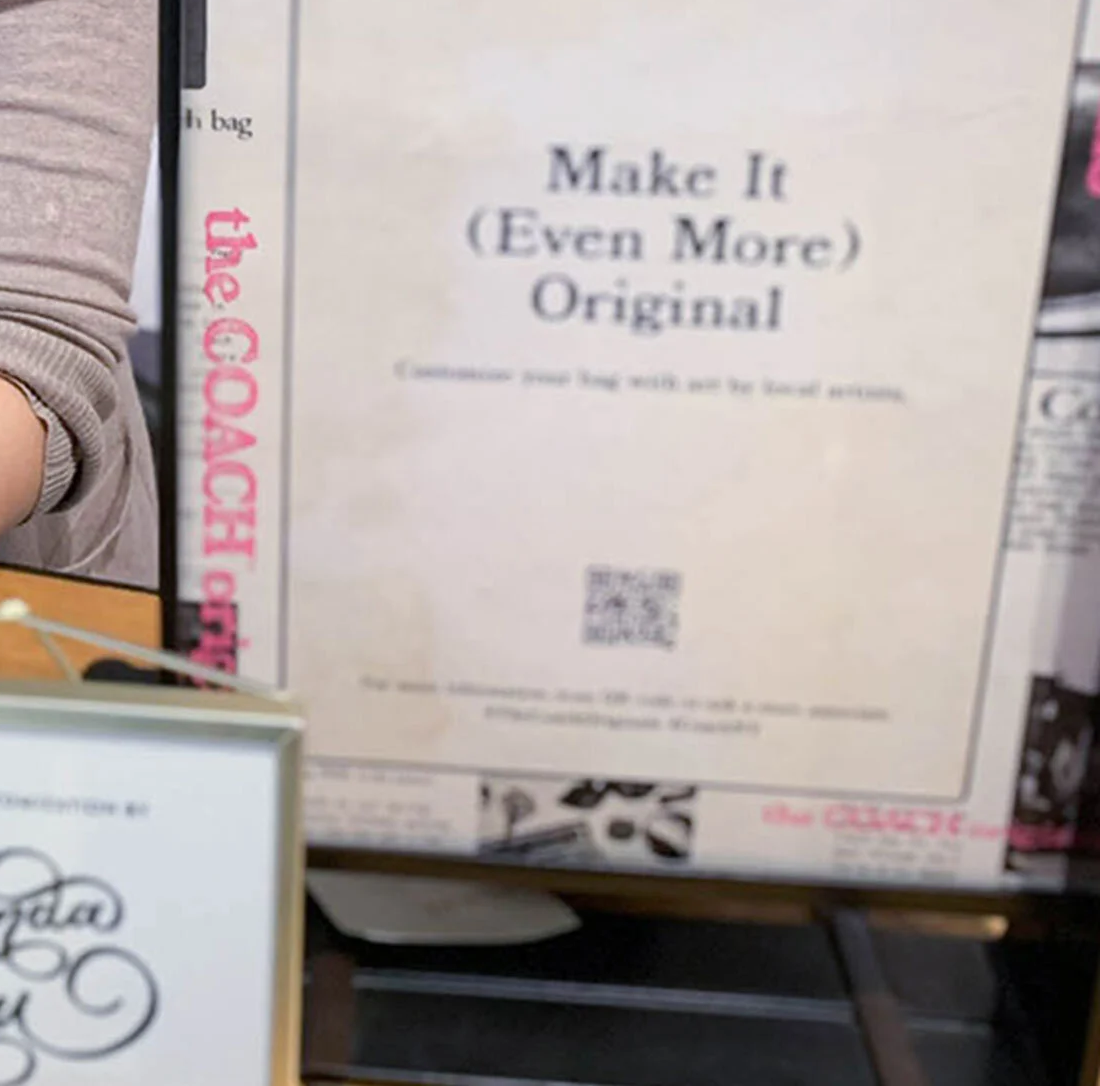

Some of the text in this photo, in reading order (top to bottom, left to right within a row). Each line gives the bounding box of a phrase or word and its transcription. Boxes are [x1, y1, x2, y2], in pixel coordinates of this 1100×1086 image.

[210, 108, 254, 141] bag
[546, 145, 789, 201] Make It
[201, 207, 260, 306] the
[465, 207, 863, 272] (Even More)
[530, 272, 784, 334] Original
[199, 316, 261, 558] COACH
